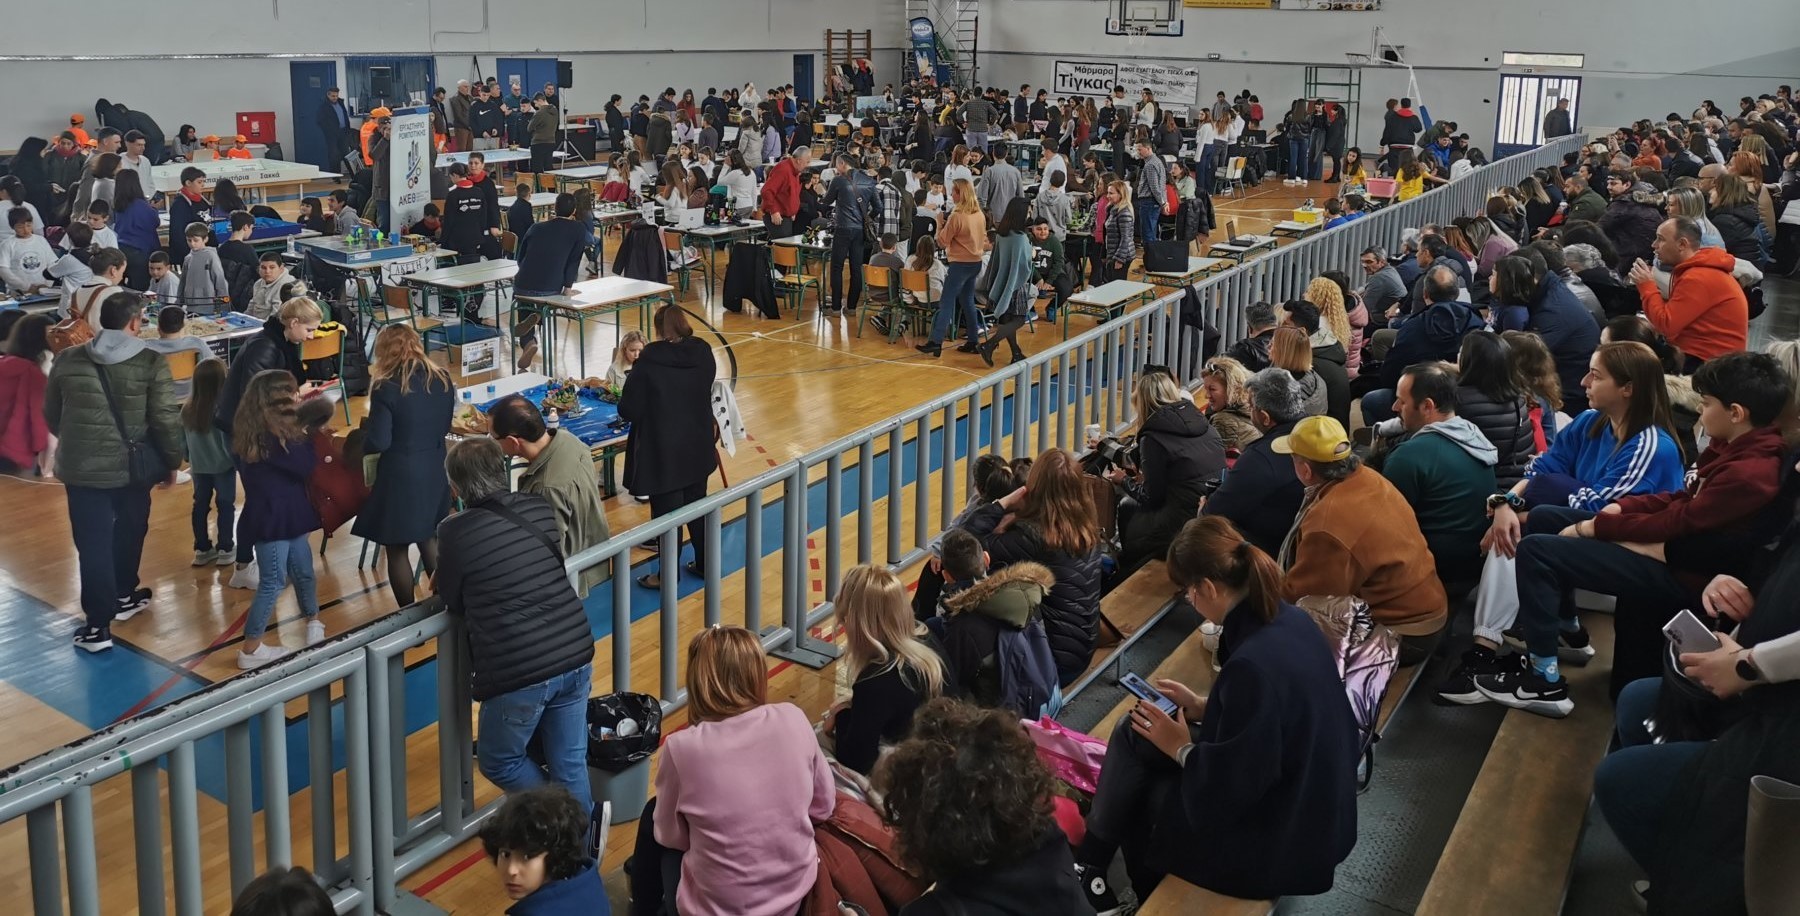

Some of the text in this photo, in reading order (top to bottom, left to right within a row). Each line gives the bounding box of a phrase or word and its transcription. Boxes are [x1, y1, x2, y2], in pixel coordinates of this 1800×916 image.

[1074, 65, 1113, 76] Μάρμαρα
[1058, 73, 1113, 93] Τίγκας
[260, 171, 280, 179] Σακκά
[398, 192, 416, 207] ΑΚΕΘ
